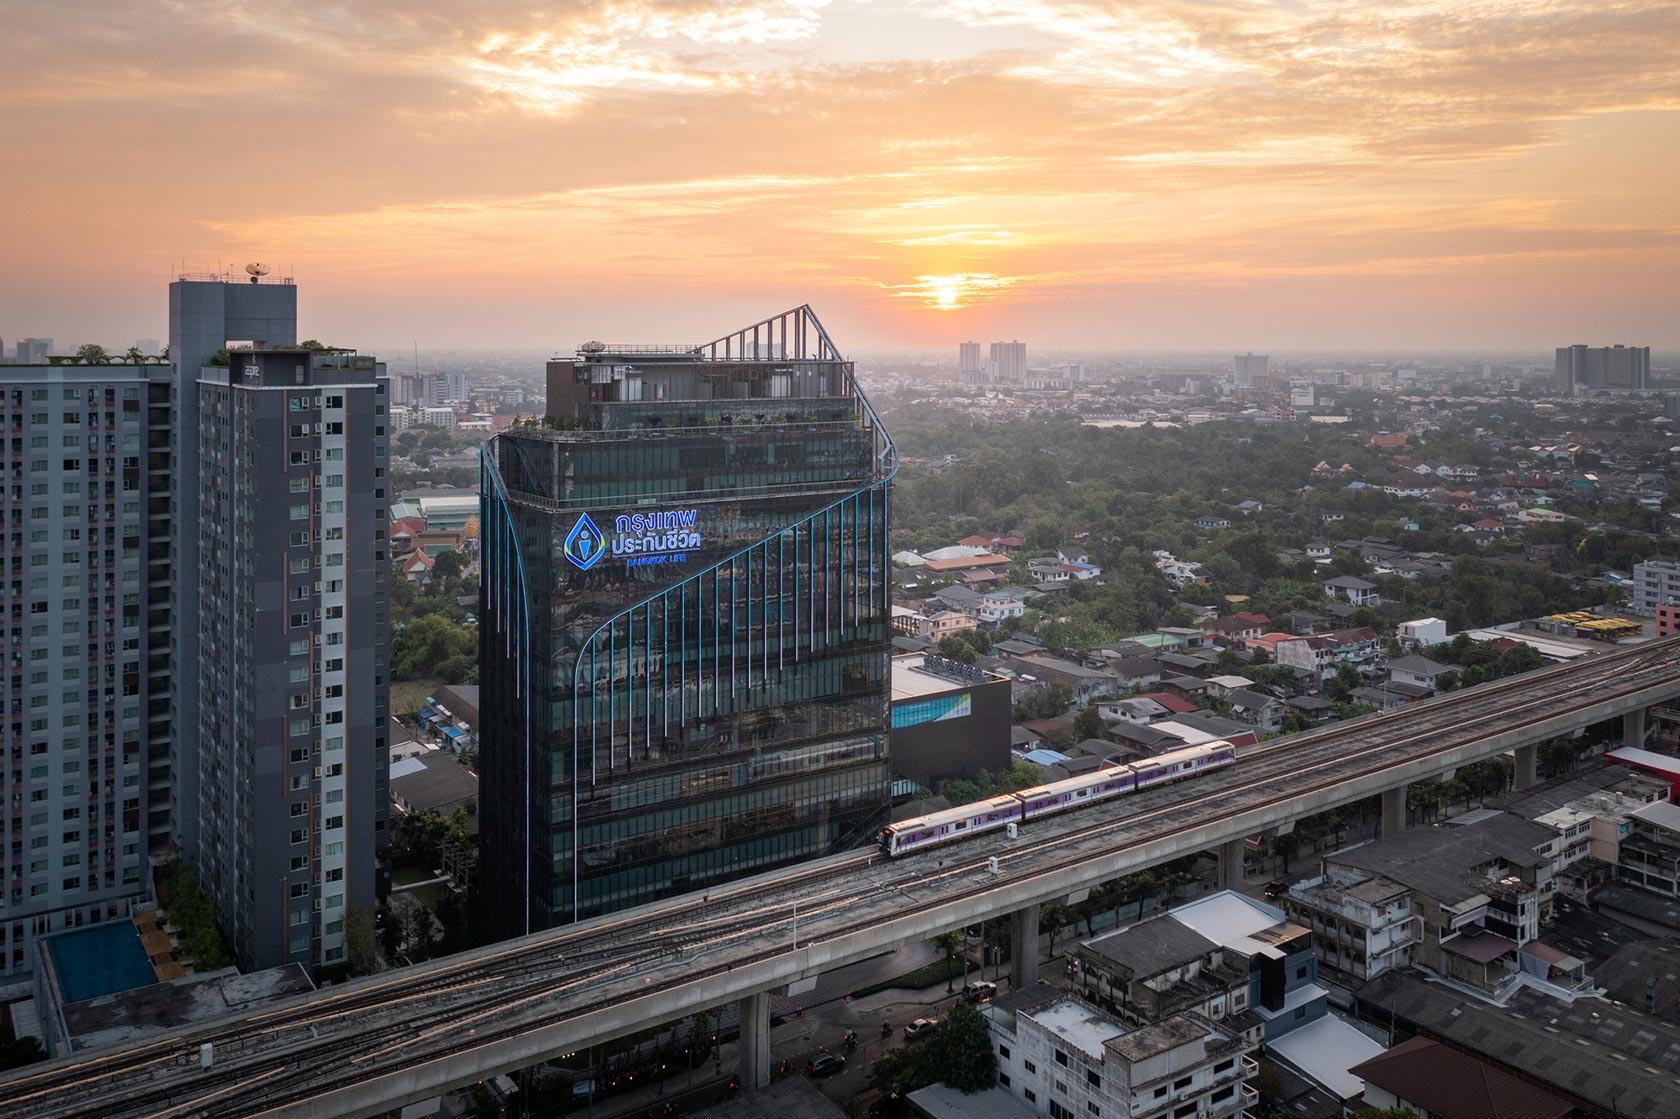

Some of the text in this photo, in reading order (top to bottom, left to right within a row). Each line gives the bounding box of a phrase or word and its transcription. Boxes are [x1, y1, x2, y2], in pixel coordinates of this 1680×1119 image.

[616, 509, 697, 537] กรุงเทพ
[612, 528, 701, 554] ประกันชีวิต
[627, 554, 687, 567] BANGKOK LIFE
